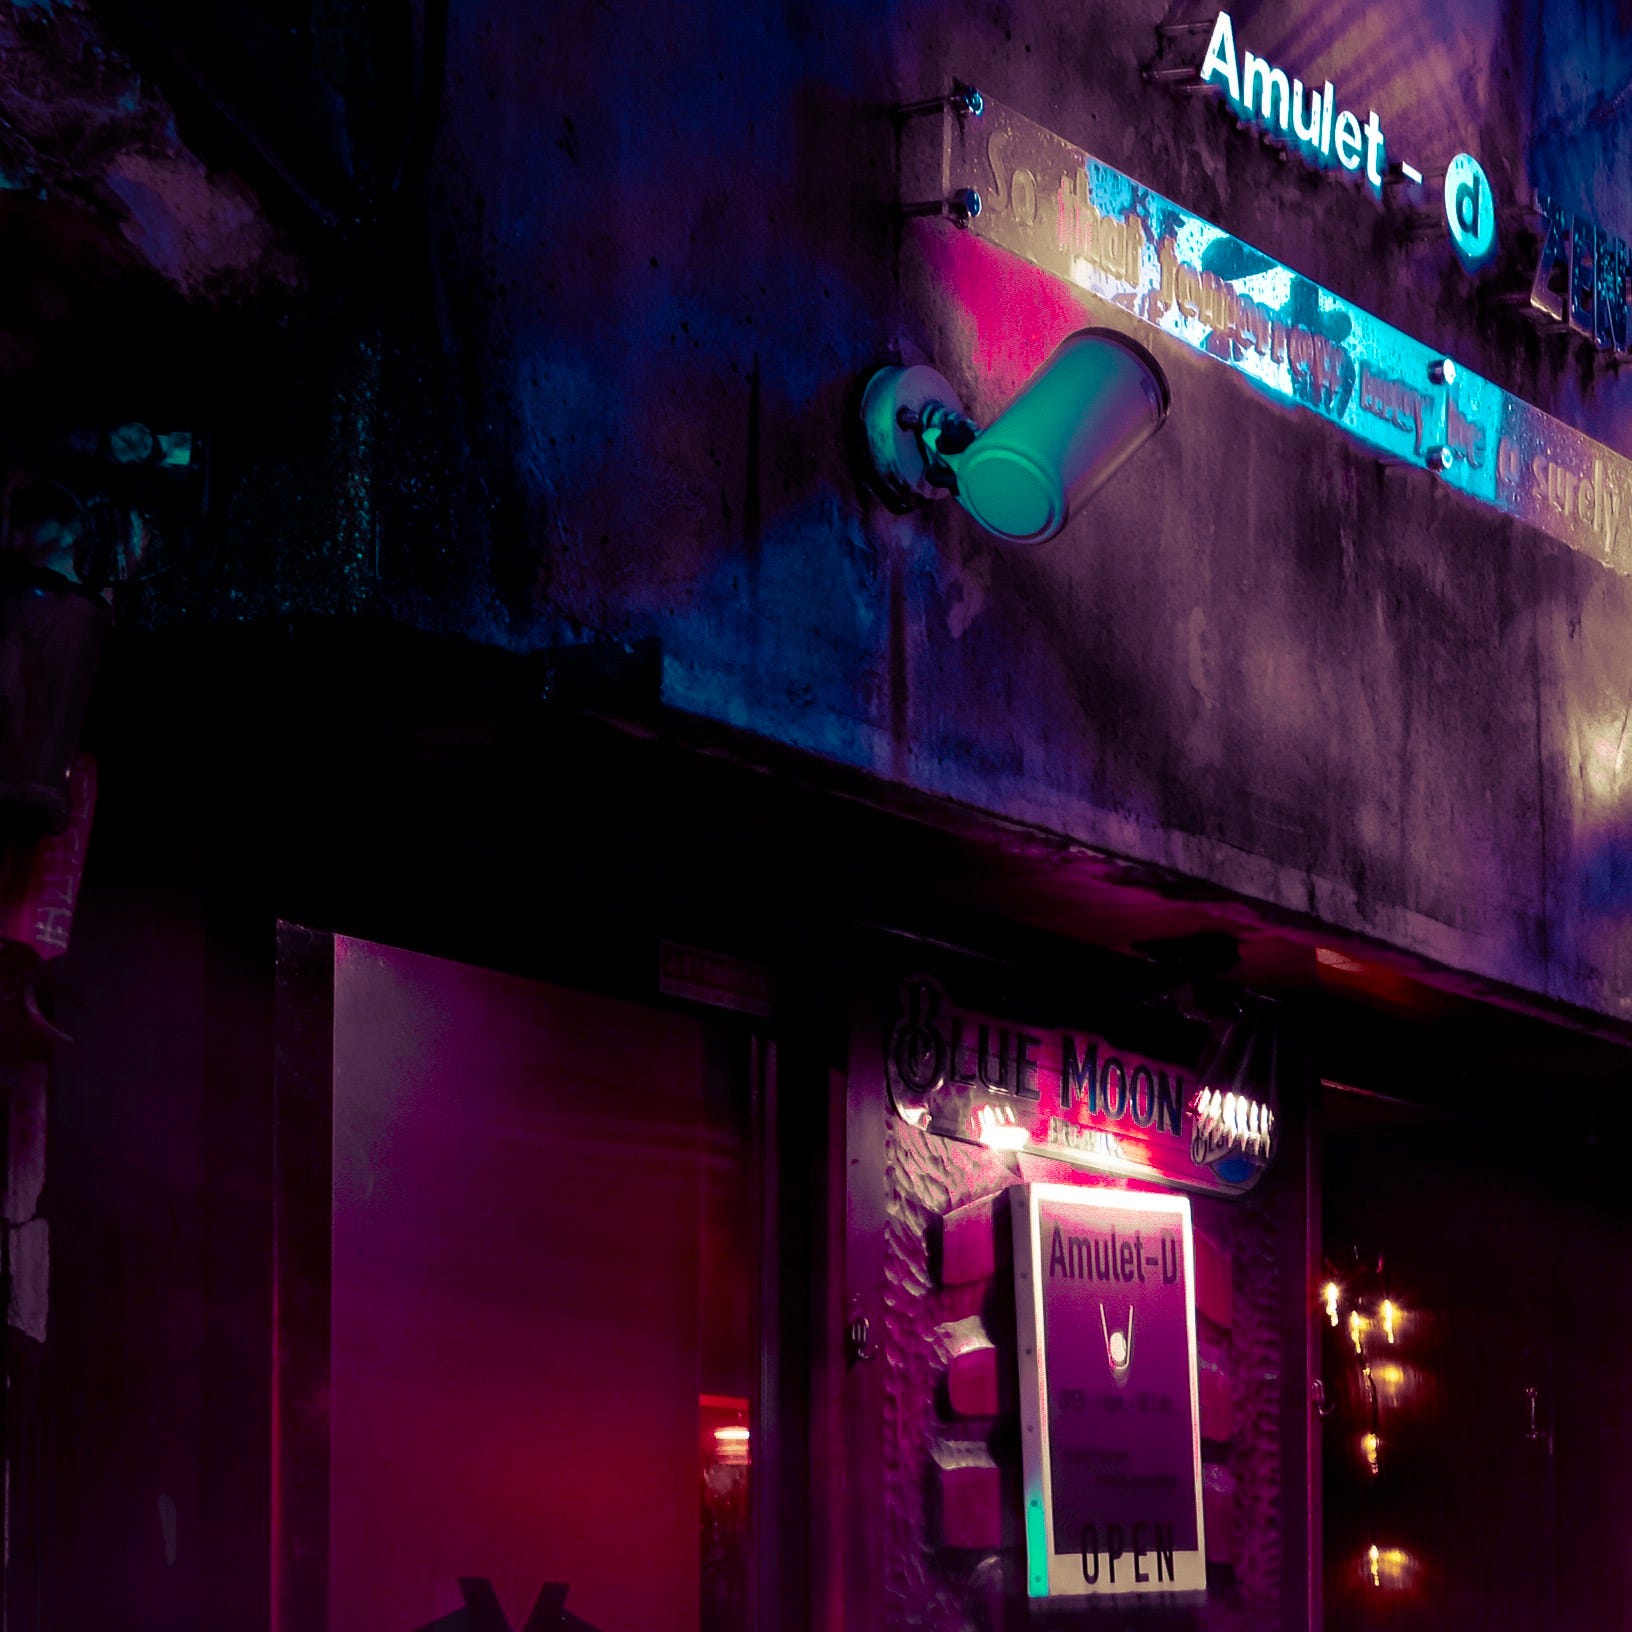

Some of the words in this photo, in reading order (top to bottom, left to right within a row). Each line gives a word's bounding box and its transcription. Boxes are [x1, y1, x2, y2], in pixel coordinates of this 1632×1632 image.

[1202, 10, 1385, 187] Amulet
[987, 130, 1037, 227] So
[1057, 166, 1144, 287] that
[1532, 456, 1621, 553] surely
[893, 973, 1041, 1101] BLUE
[1061, 1035, 1184, 1137] MOON
[1049, 1223, 1178, 1286] Amulet-D
[1081, 1522, 1175, 1585] OPEN
